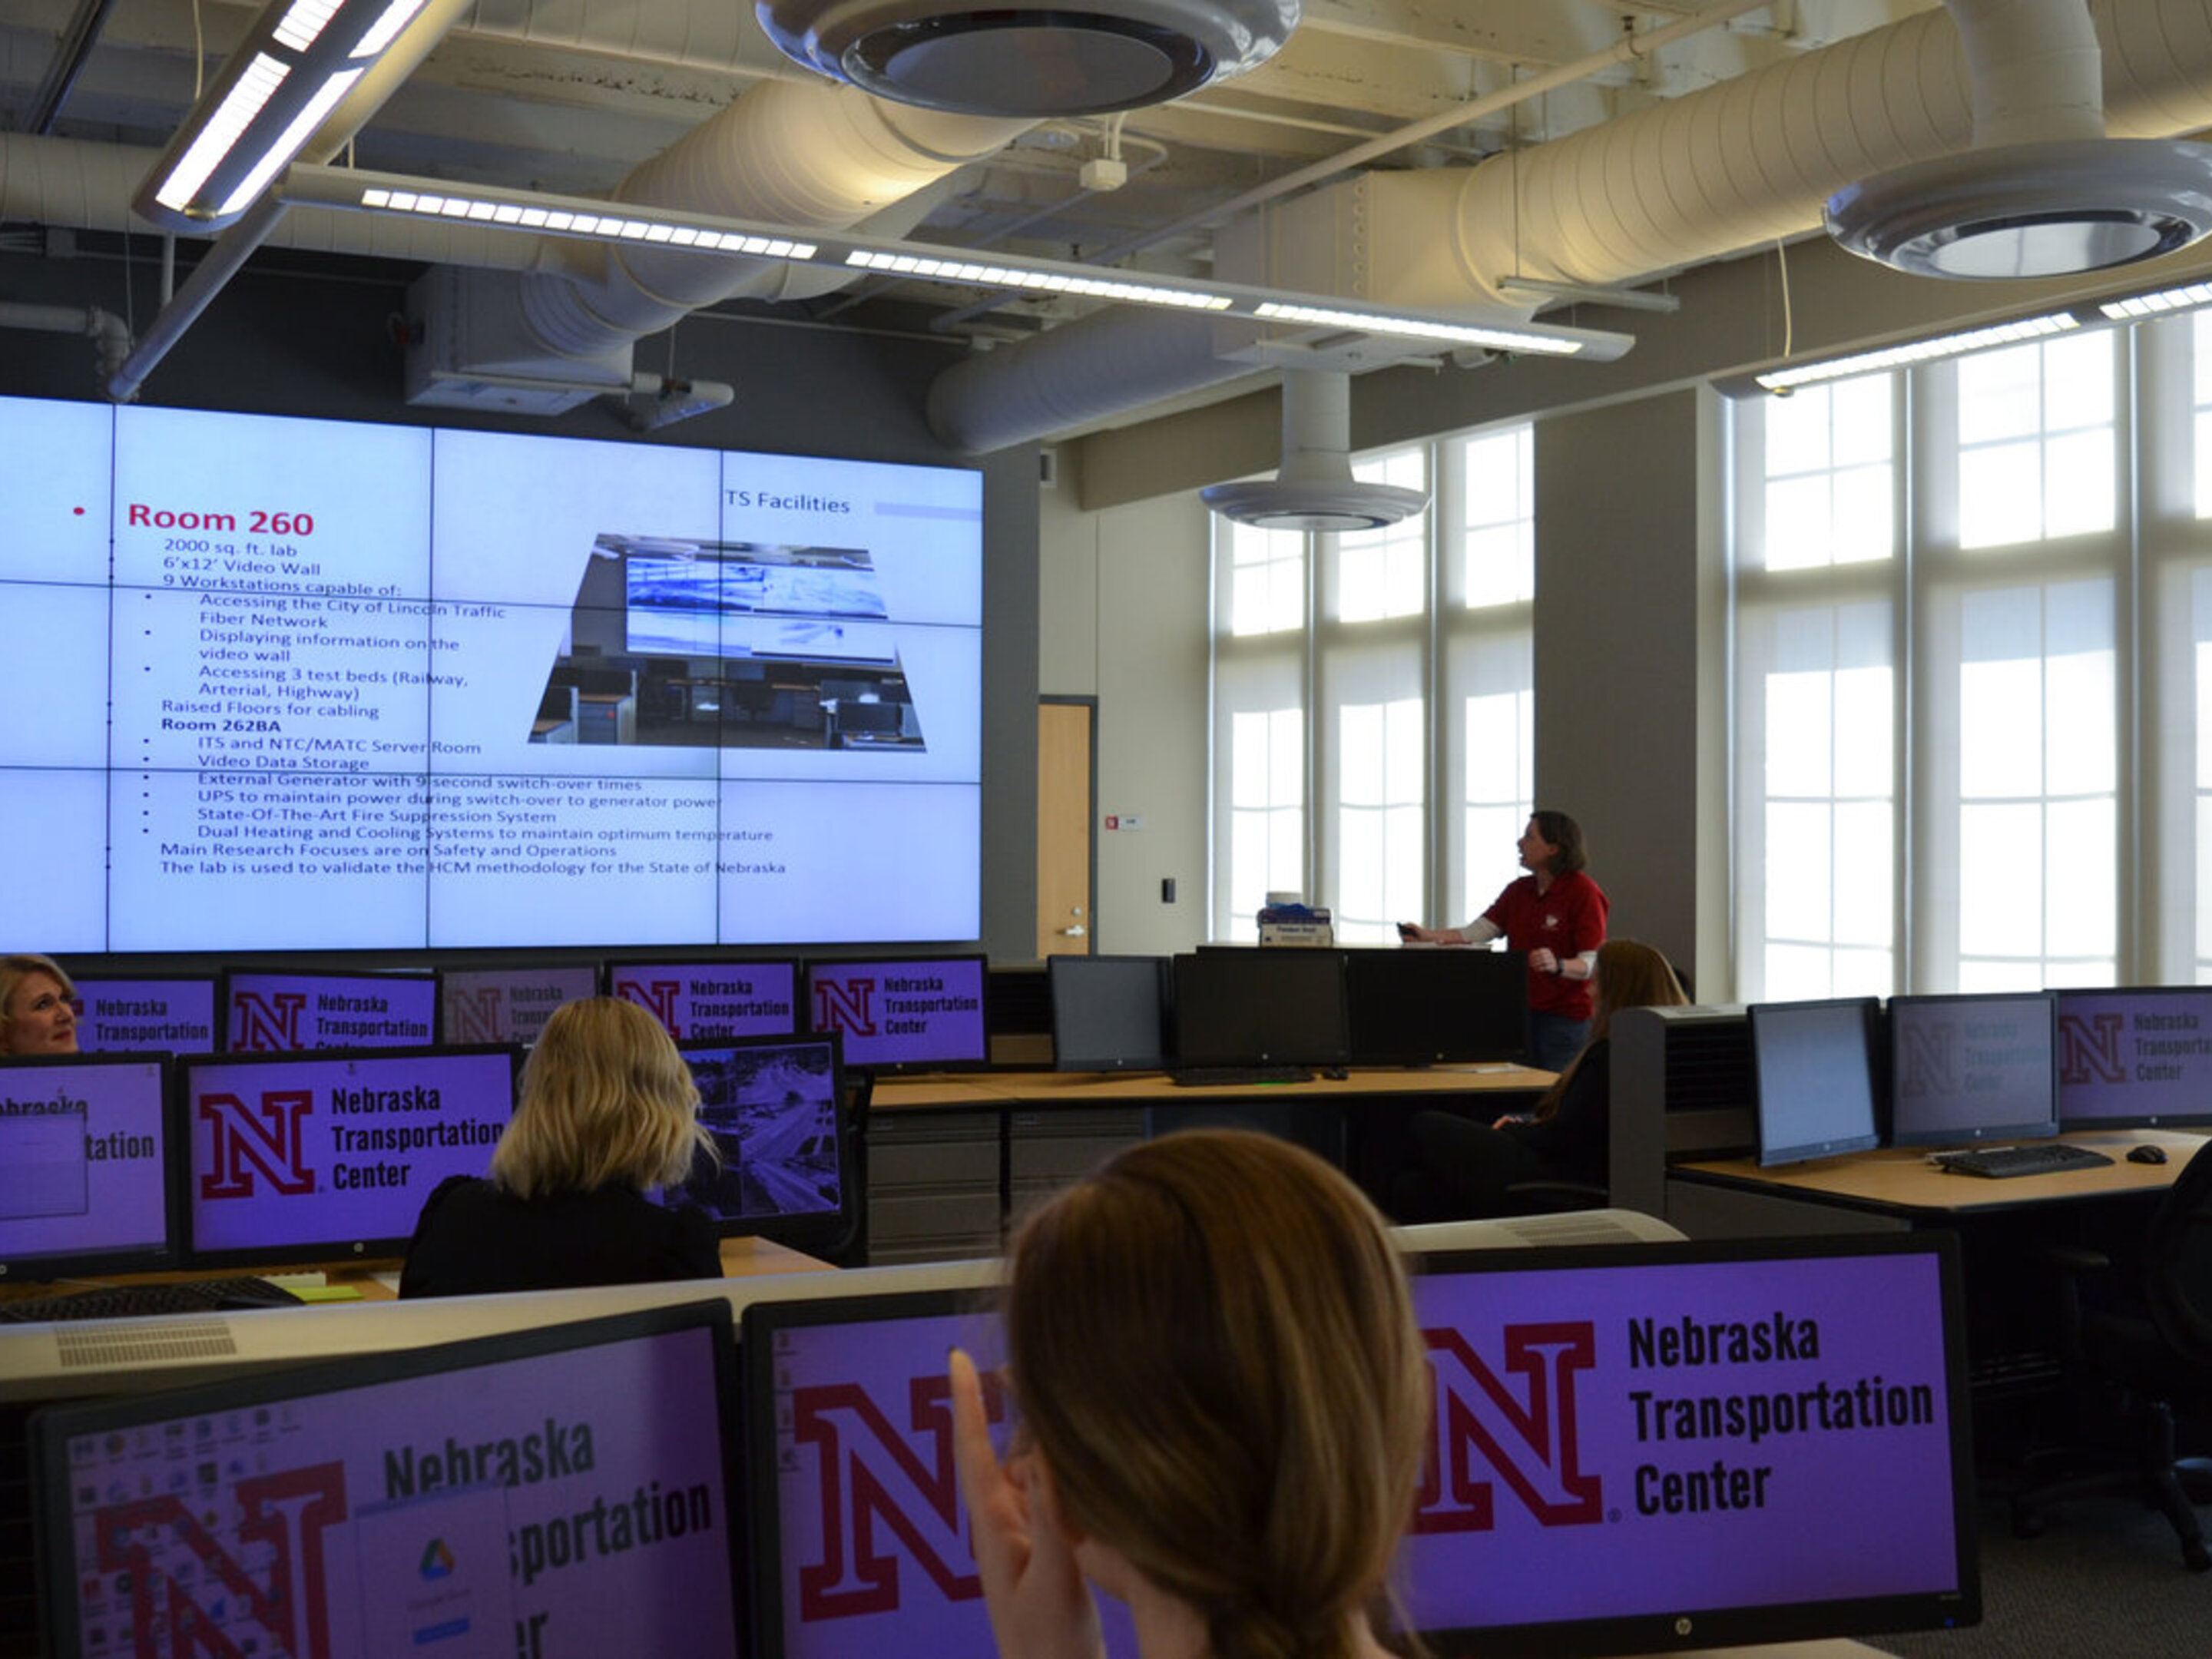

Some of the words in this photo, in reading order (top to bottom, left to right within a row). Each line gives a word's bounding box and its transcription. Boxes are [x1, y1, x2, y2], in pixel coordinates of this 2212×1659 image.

[758, 492, 850, 514] Facilities
[128, 504, 236, 531] Room
[249, 511, 314, 536] 260
[164, 539, 209, 552] 2000
[214, 543, 240, 557] sq.
[245, 541, 266, 556] ft.
[270, 543, 297, 557] lab
[224, 559, 275, 574] Video
[280, 562, 320, 575] Wall
[164, 575, 174, 587] 9
[180, 575, 300, 592] Workstations
[305, 581, 373, 597] capable
[378, 584, 402, 597] of:
[200, 594, 286, 612] Accessing
[292, 598, 321, 611] the
[326, 599, 359, 615] City
[364, 601, 382, 613] of
[455, 604, 506, 618] Traffic
[200, 612, 245, 626] Fiber
[251, 614, 327, 628] Network
[200, 630, 291, 647] Displaying
[296, 633, 399, 649] information
[404, 639, 426, 649] on
[430, 637, 459, 650] the
[200, 647, 250, 661] video
[254, 649, 290, 661] wall
[200, 665, 286, 682] Accessing
[292, 667, 301, 680] 3
[307, 669, 339, 681] test
[345, 669, 386, 683] beds
[200, 683, 272, 699] Arterial,
[277, 685, 359, 701] Highway)
[162, 700, 221, 714] Raised
[228, 701, 283, 715] Floors
[287, 703, 312, 715] for
[317, 703, 379, 720] cabling
[162, 719, 217, 731] Room
[223, 720, 281, 732] 262BA
[198, 737, 224, 750] ITS
[230, 738, 264, 750] and
[270, 737, 366, 753] NTC/MATC
[373, 740, 426, 753] Server
[432, 741, 481, 753] Room
[198, 755, 250, 768] Video
[257, 756, 296, 768] Data
[303, 757, 369, 771] Storage
[198, 773, 271, 785] External
[278, 773, 367, 786] Generator
[373, 775, 410, 786] with
[416, 775, 426, 786] 9
[432, 777, 492, 789] second
[498, 777, 593, 791] switch-over
[598, 779, 641, 791] times
[198, 790, 233, 803] UPS
[240, 792, 259, 803] to
[264, 790, 340, 804] maintain
[347, 793, 401, 807] power
[466, 793, 563, 806] switch-over
[568, 796, 584, 806] to
[589, 796, 667, 810] generator
[198, 808, 346, 821] State-Of-The-Art
[352, 809, 383, 821] Fire
[390, 809, 491, 825] Suppression
[497, 811, 556, 824] System
[198, 826, 238, 838] Dual
[244, 826, 313, 840] Heating
[318, 826, 349, 839] and
[356, 827, 420, 841] Cooling
[499, 830, 517, 839] to
[522, 827, 593, 839] maintain
[598, 828, 670, 842] optimum
[676, 830, 773, 842] temperature
[161, 844, 207, 855] Main
[212, 844, 293, 856] Research
[300, 844, 369, 856] Focuses
[375, 846, 402, 856] are
[408, 846, 428, 856] on
[434, 845, 485, 858] Safety
[492, 845, 522, 856] and
[526, 846, 617, 858] Operations
[161, 861, 193, 873] The
[200, 861, 226, 873] lab
[233, 862, 245, 873] is
[252, 862, 293, 874] used
[299, 863, 317, 874] to
[323, 861, 395, 874] validate
[397, 862, 425, 874] the
[430, 862, 471, 874] HCM
[476, 862, 585, 876] methodology
[591, 862, 613, 873] for
[618, 862, 644, 873] the
[649, 863, 689, 873] State
[694, 862, 710, 873] of
[717, 863, 786, 873] Nebraska
[690, 979, 752, 997] Nebraska
[885, 977, 943, 993] Nebraska
[96, 999, 167, 1017] Nebraska
[317, 994, 388, 1014] Nebraska
[690, 1000, 790, 1020] Transportation
[815, 979, 876, 1037] N
[885, 997, 978, 1016] Transportation
[235, 992, 305, 1050] N
[316, 1018, 428, 1038] Transportation
[886, 1018, 926, 1035] Center
[2134, 1012, 2198, 1031] Nebraska
[95, 1023, 208, 1043] Transportation
[692, 1022, 734, 1040] Center
[2136, 1063, 2184, 1082] Center
[332, 1085, 441, 1114] Nebraska
[199, 1090, 314, 1199] N
[332, 1120, 503, 1153] Transportation
[333, 1163, 410, 1190] Center
[1628, 1311, 1820, 1369] Nebraska
[1630, 1376, 1933, 1443] Transportation
[384, 1417, 595, 1501] Nebraska
[1634, 1461, 1772, 1515] Center
